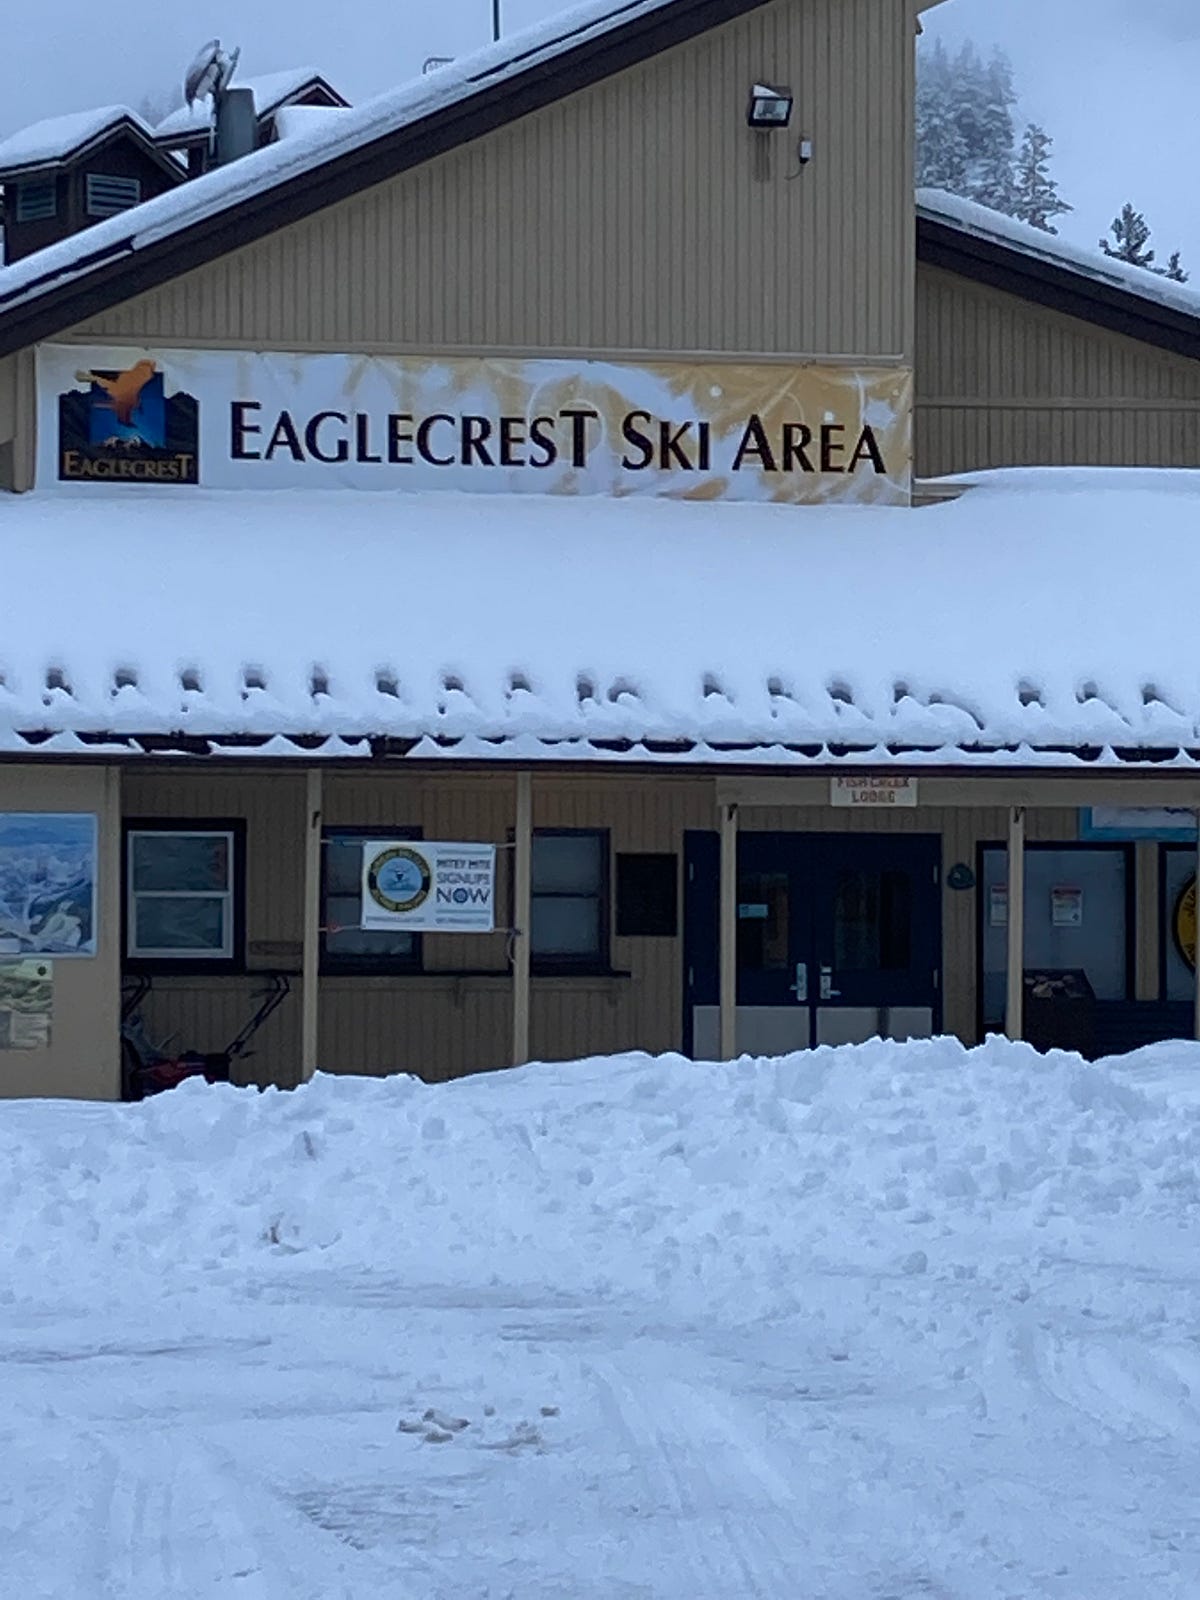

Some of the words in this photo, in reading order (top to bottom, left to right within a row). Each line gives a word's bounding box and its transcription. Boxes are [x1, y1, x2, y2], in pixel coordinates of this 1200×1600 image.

[230, 401, 598, 468] EAGLECREST
[621, 410, 711, 471] SKI
[732, 413, 887, 474] AREA
[63, 450, 194, 480] EAGLECREST
[436, 886, 491, 904] NOW
